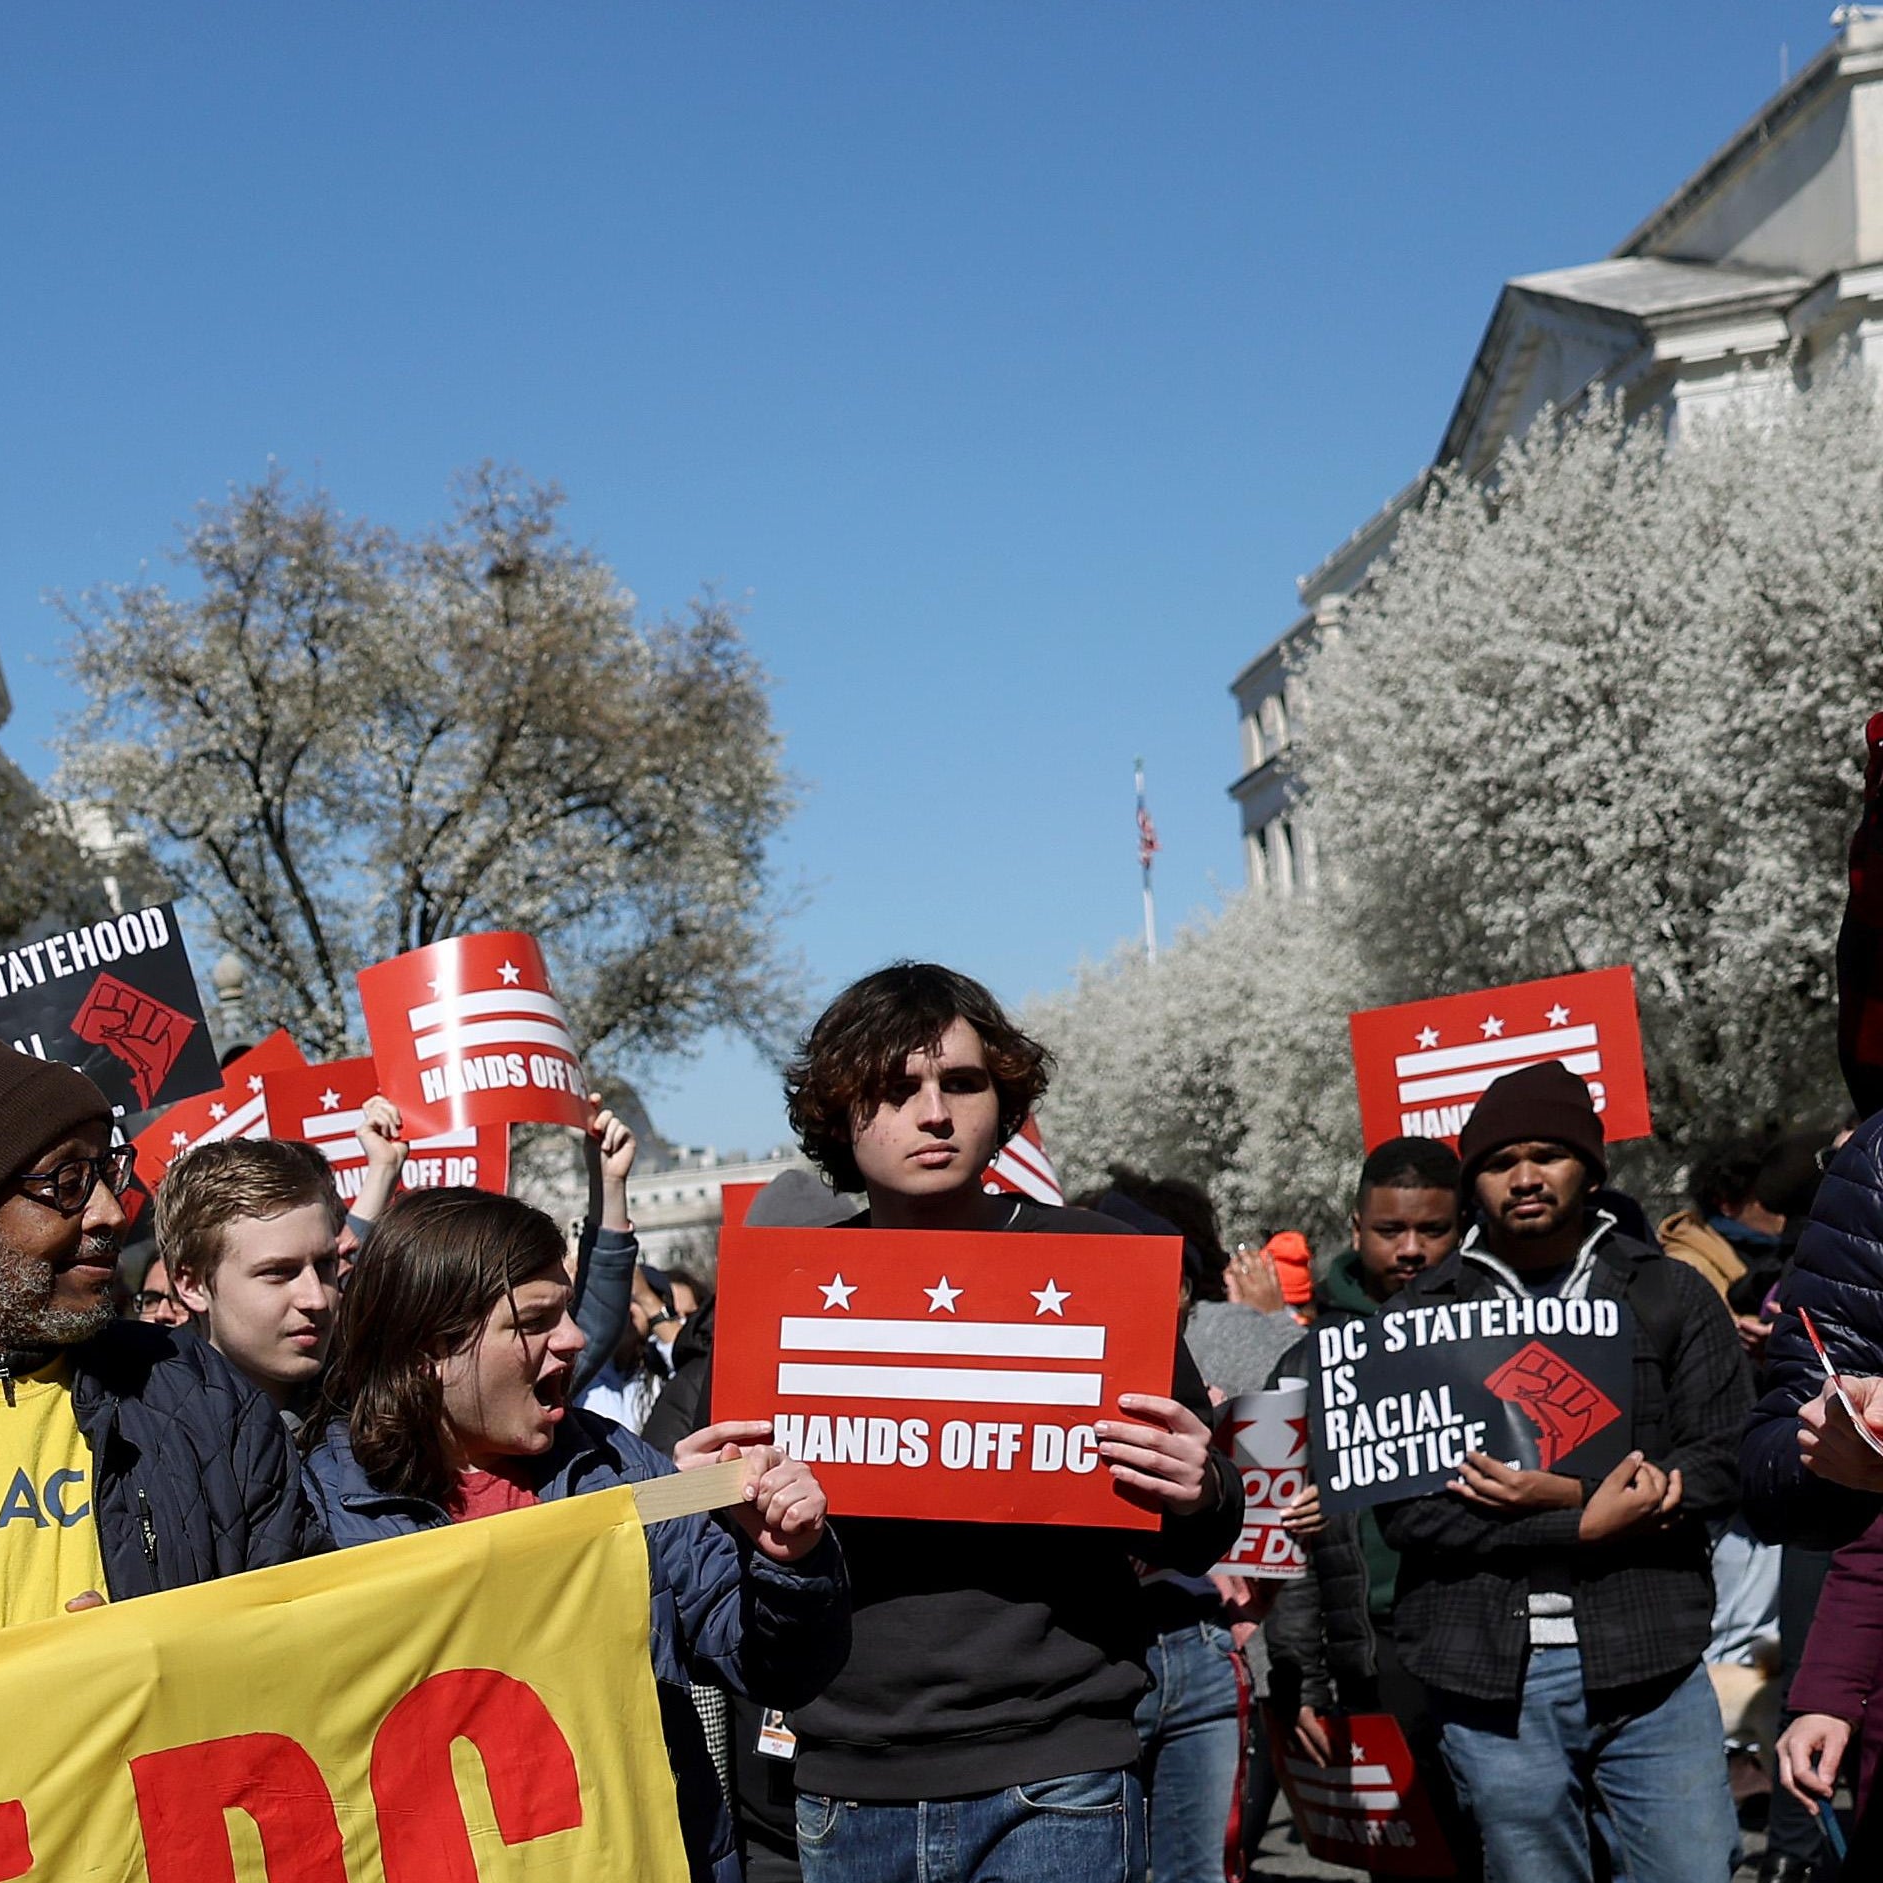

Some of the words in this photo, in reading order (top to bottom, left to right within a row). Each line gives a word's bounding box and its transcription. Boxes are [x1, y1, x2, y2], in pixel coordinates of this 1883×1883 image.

[529, 1054, 565, 1091] OFF
[402, 1158, 442, 1190] OFF
[445, 1156, 477, 1187] DC
[1319, 1319, 1367, 1368] DC
[1383, 1297, 1619, 1353] STATEHOOD
[1321, 1364, 1357, 1408] IS
[774, 1414, 930, 1468] HANDS
[939, 1419, 1023, 1470] OFF
[1031, 1424, 1099, 1474] DC
[1325, 1385, 1464, 1450] RACIAL
[1330, 1421, 1486, 1492] JUSTICE
